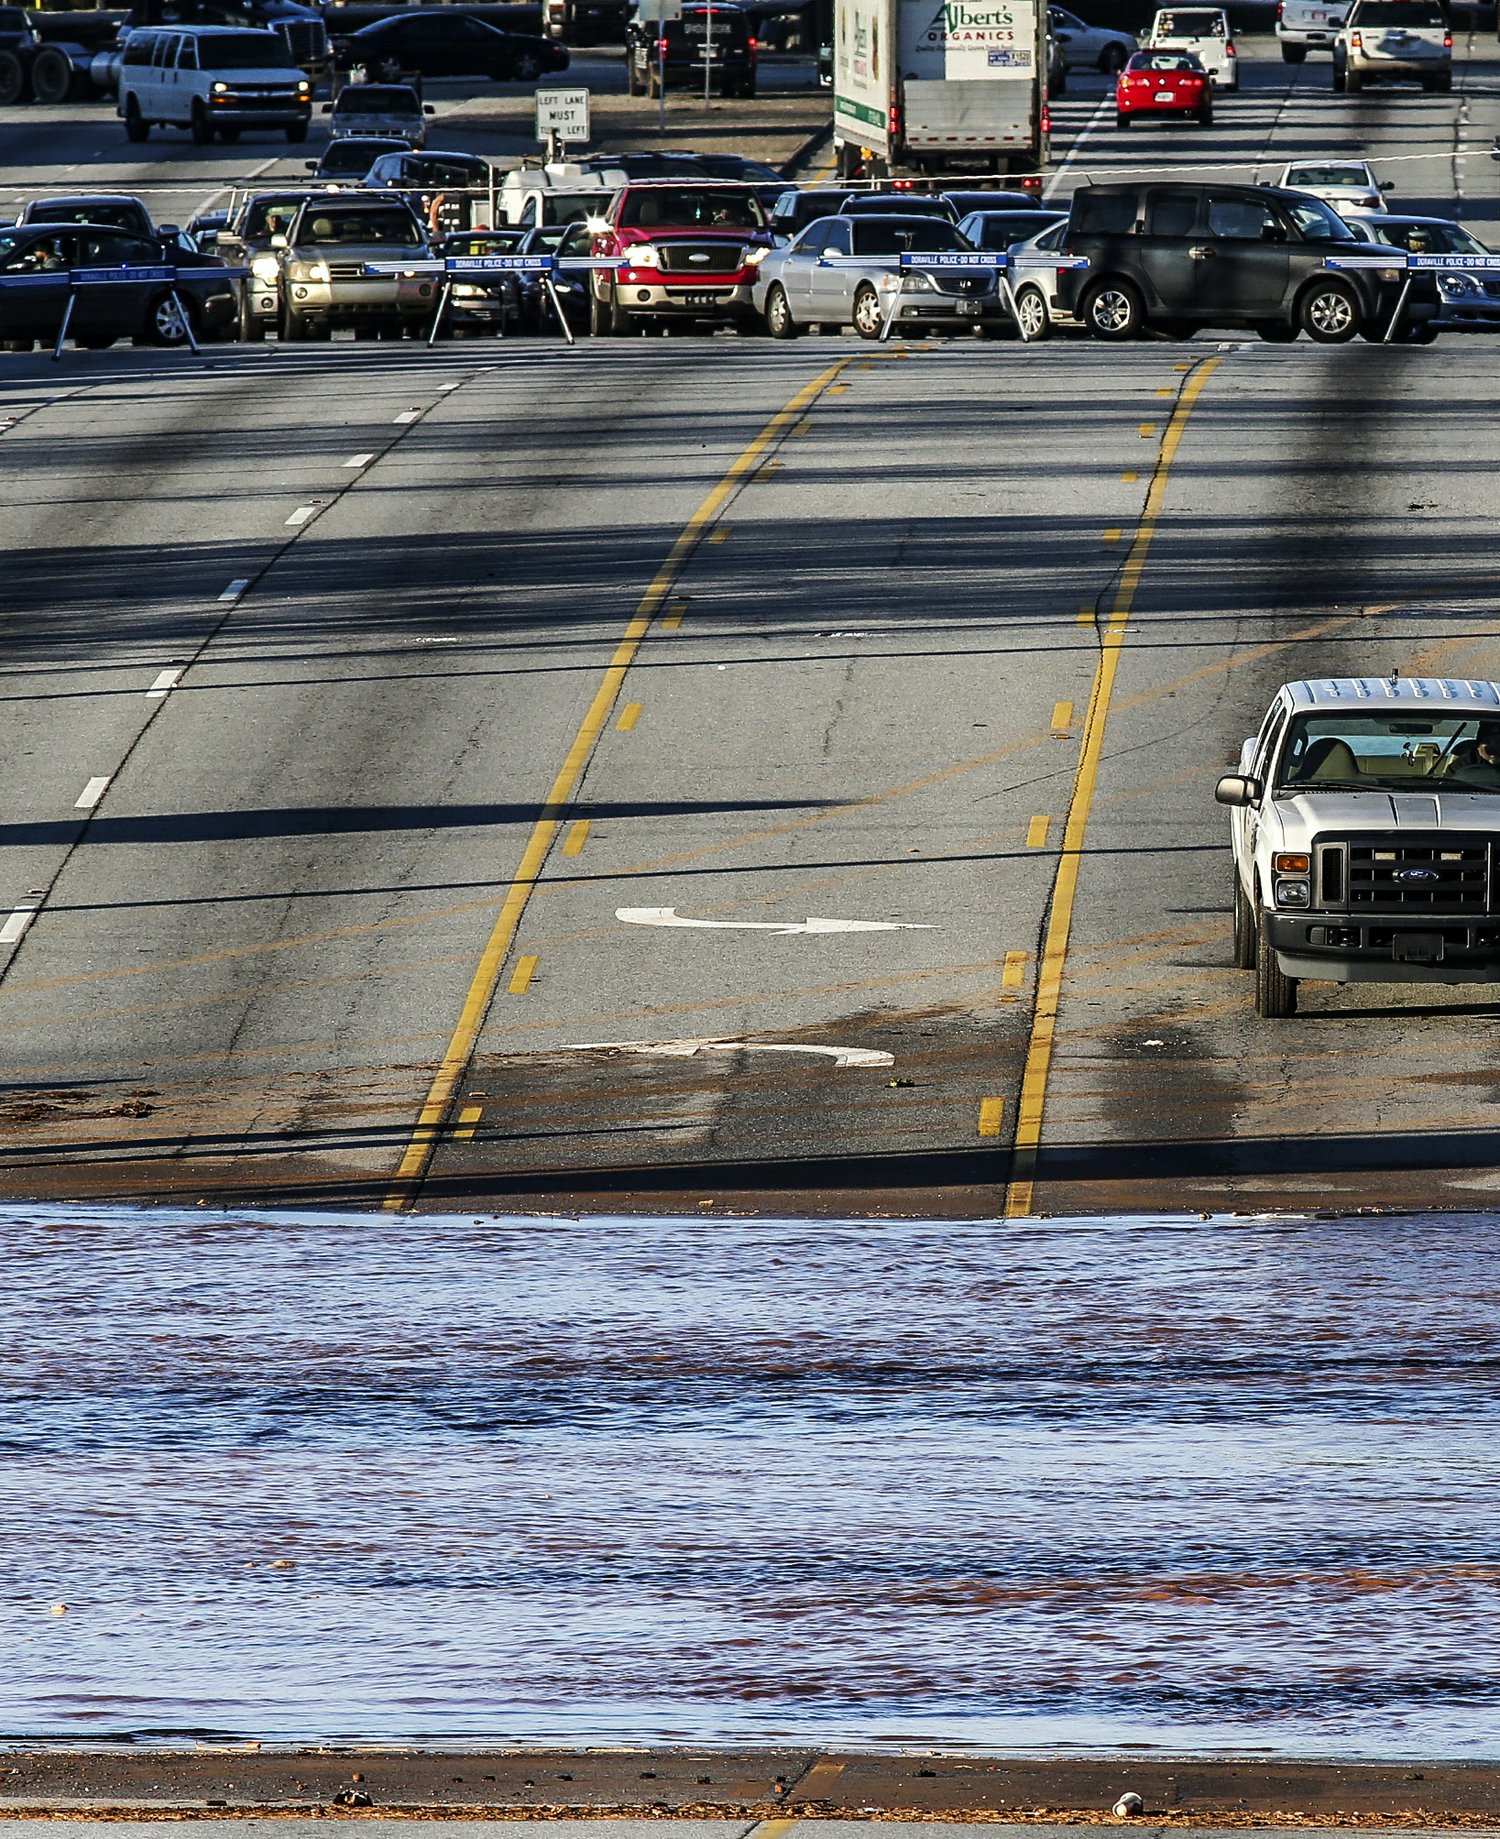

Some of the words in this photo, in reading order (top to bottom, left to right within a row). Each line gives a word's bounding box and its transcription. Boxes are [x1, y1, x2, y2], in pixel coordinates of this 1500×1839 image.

[918, 2, 1013, 35] Albert's
[928, 31, 1014, 41] ORGANICS
[539, 96, 558, 104] LEFT
[565, 96, 584, 104] LANE
[550, 110, 574, 120] MUST
[567, 126, 586, 135] LEFT
[911, 255, 938, 264] DORAVILLE
[1417, 257, 1444, 266] DORAVILLE
